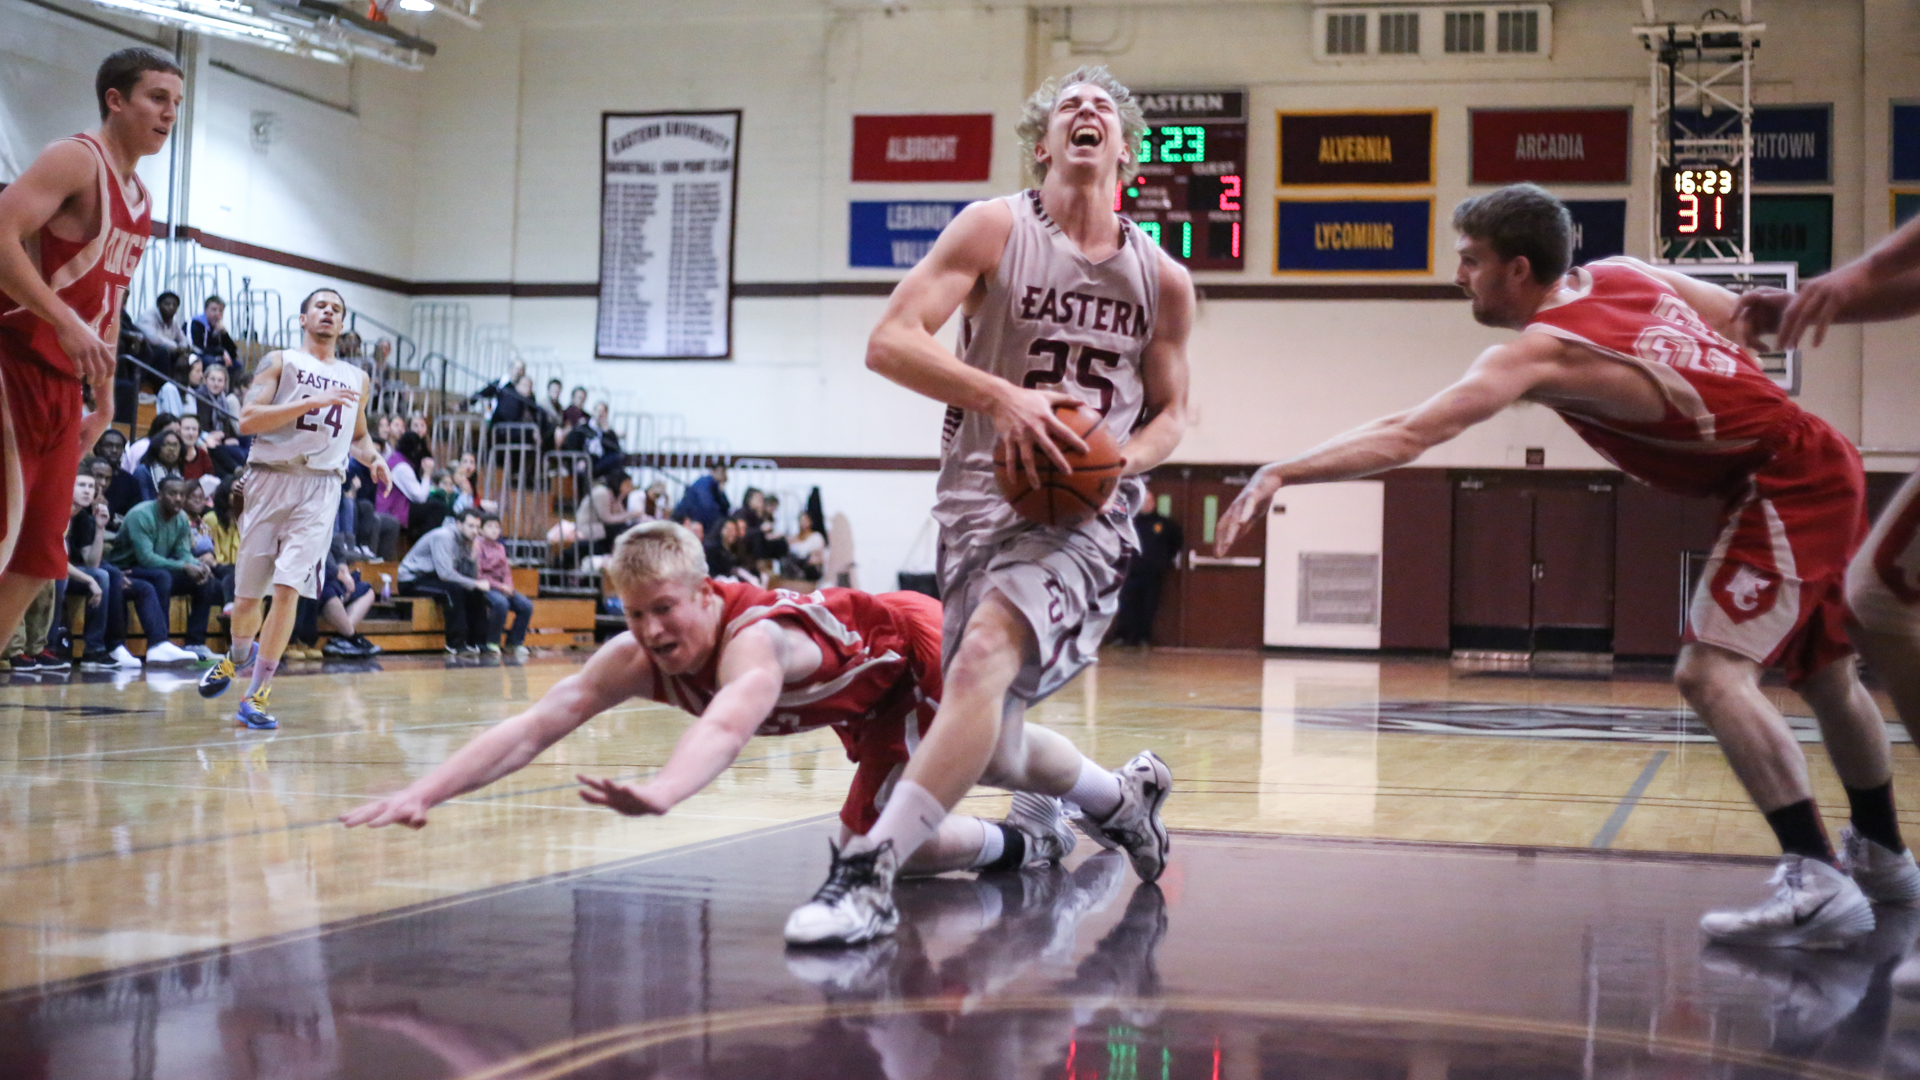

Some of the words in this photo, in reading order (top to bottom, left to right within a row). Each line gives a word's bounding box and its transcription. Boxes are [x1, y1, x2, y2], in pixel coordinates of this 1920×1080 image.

[611, 123, 660, 155] EASTERN
[665, 121, 729, 153] UNIVERSITY
[885, 135, 958, 162] ALBRIGHT
[1318, 135, 1392, 162] ALVERNIA
[1516, 133, 1585, 160] ARCADIA
[1219, 175, 1241, 211] 2
[1674, 170, 1733, 194] 16:23
[886, 203, 954, 231] LEBANON
[1314, 222, 1394, 249] LYCOMING
[1021, 285, 1149, 338] EASTERN
[1022, 337, 1121, 418] 25
[295, 394, 343, 438] 24
